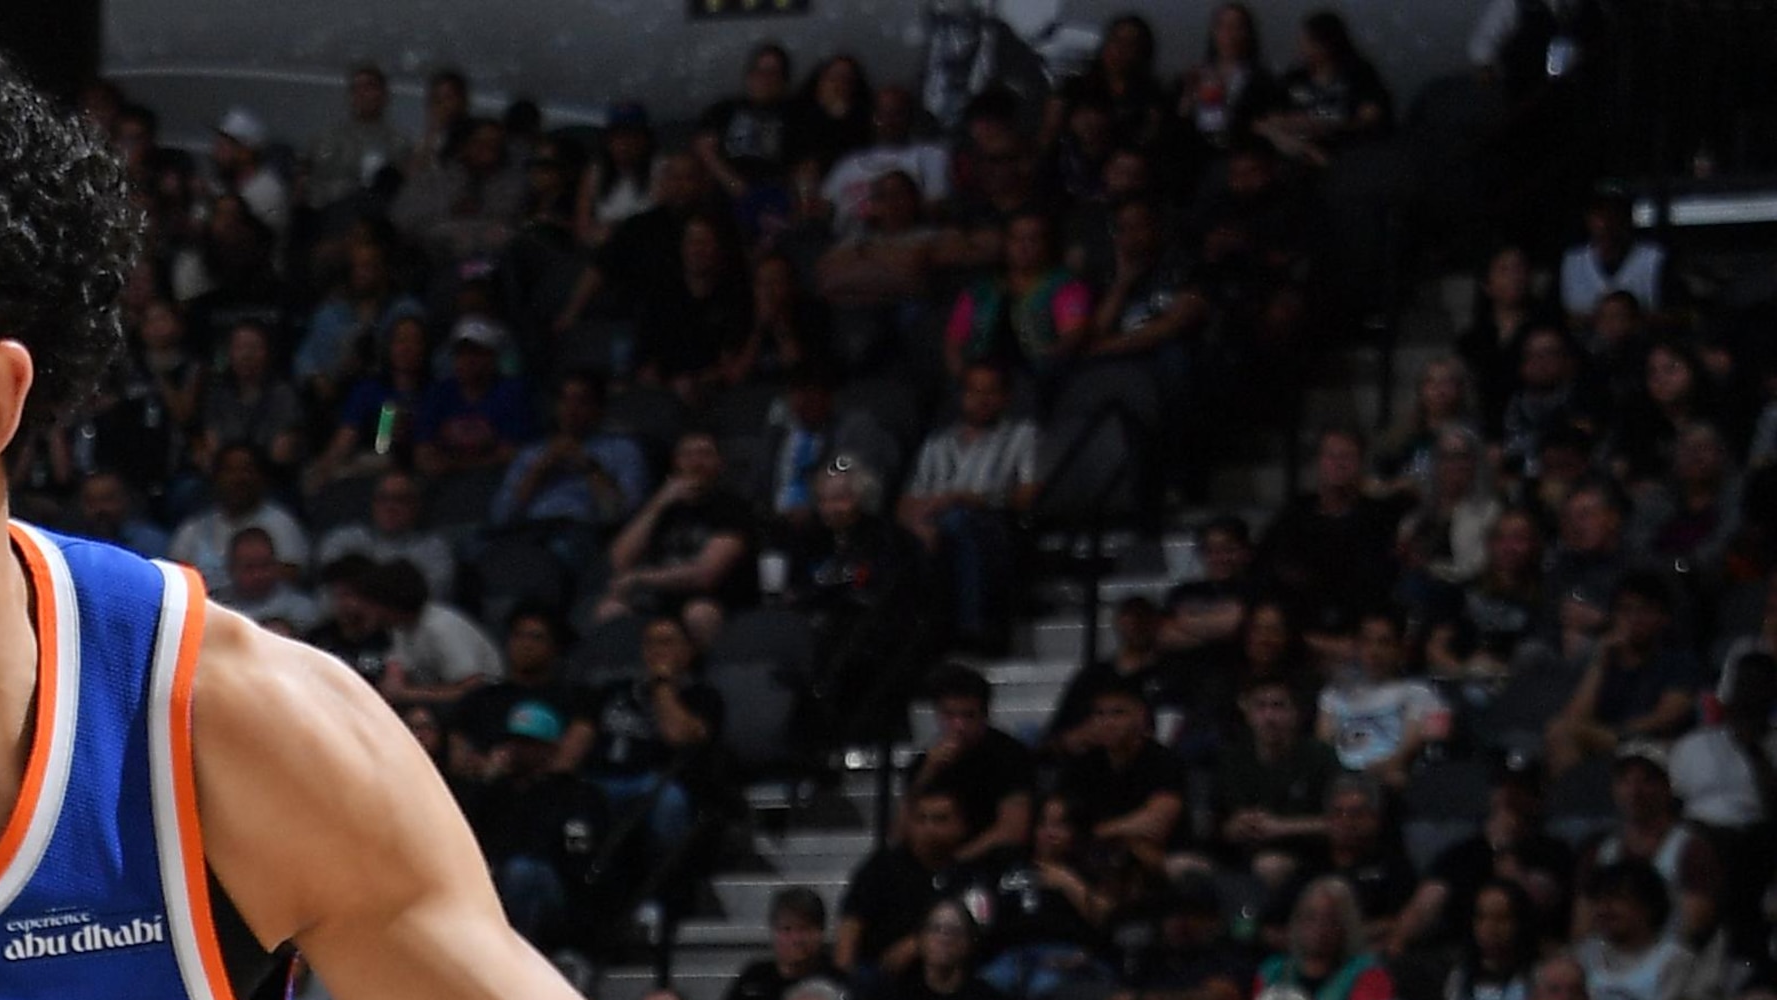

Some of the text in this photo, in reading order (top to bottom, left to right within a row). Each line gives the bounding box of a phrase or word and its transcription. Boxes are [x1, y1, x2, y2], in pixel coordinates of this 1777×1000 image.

[4, 915, 164, 960] abu dhabi
[6, 912, 92, 932] experience
